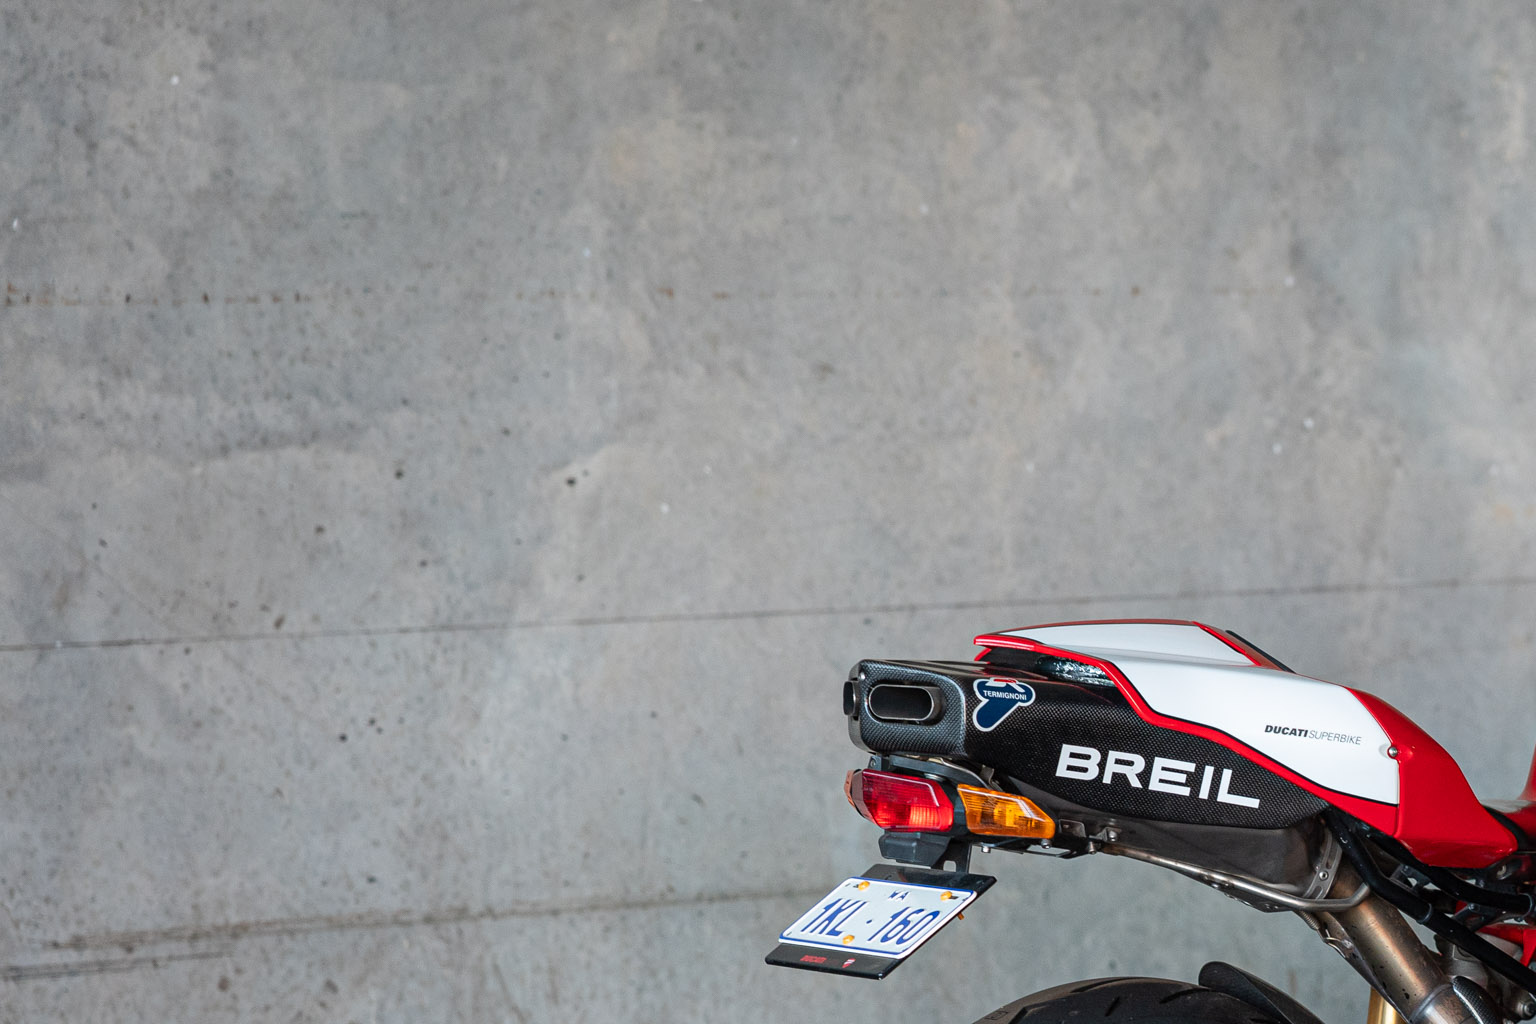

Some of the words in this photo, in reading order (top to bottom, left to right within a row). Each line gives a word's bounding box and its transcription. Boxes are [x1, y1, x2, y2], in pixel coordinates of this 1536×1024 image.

[982, 689, 1027, 701] TERMIGNONI
[1264, 724, 1309, 738] DUCATI
[1308, 729, 1362, 746] SUPERBIKE
[1055, 743, 1260, 809] BREIL
